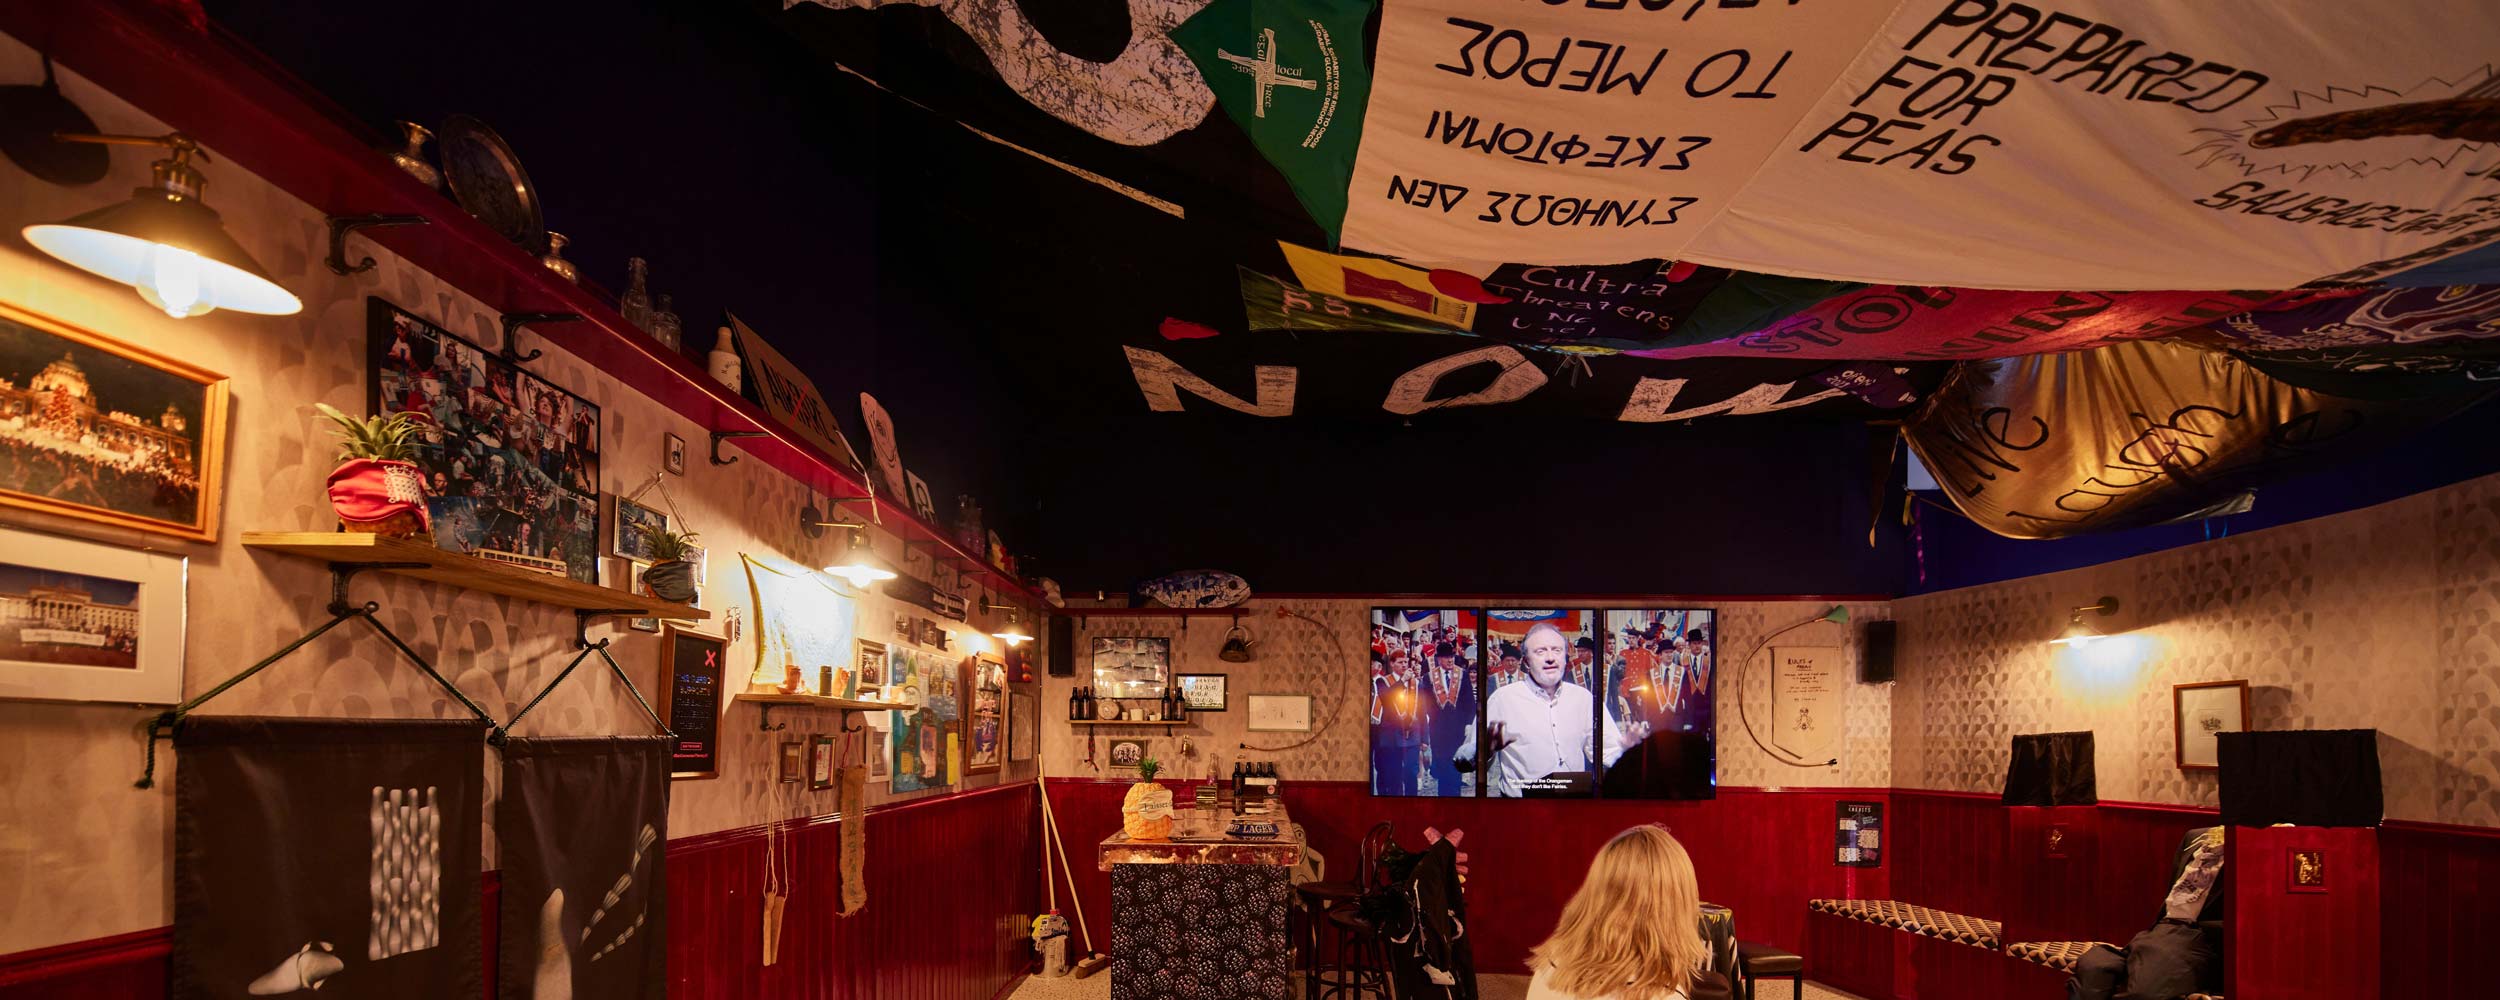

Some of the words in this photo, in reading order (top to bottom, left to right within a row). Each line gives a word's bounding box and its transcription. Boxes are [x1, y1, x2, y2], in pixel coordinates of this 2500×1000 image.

[1277, 64, 1302, 77] local
[1436, 17, 1668, 96] ΜΕΡΟΣ
[1902, 0, 2269, 113] PREPARED
[1850, 55, 2016, 126] FOR
[1424, 110, 1712, 170] ΣΚΕΦΤΟΜΑΙ
[1800, 111, 2002, 175] PEAS
[1388, 175, 1469, 213] ΔΕΝ
[1479, 190, 1699, 226] ΣΥΝΗΘΩΣ
[1520, 266, 1669, 298] Cultra
[1243, 824, 1274, 833] LAGER
